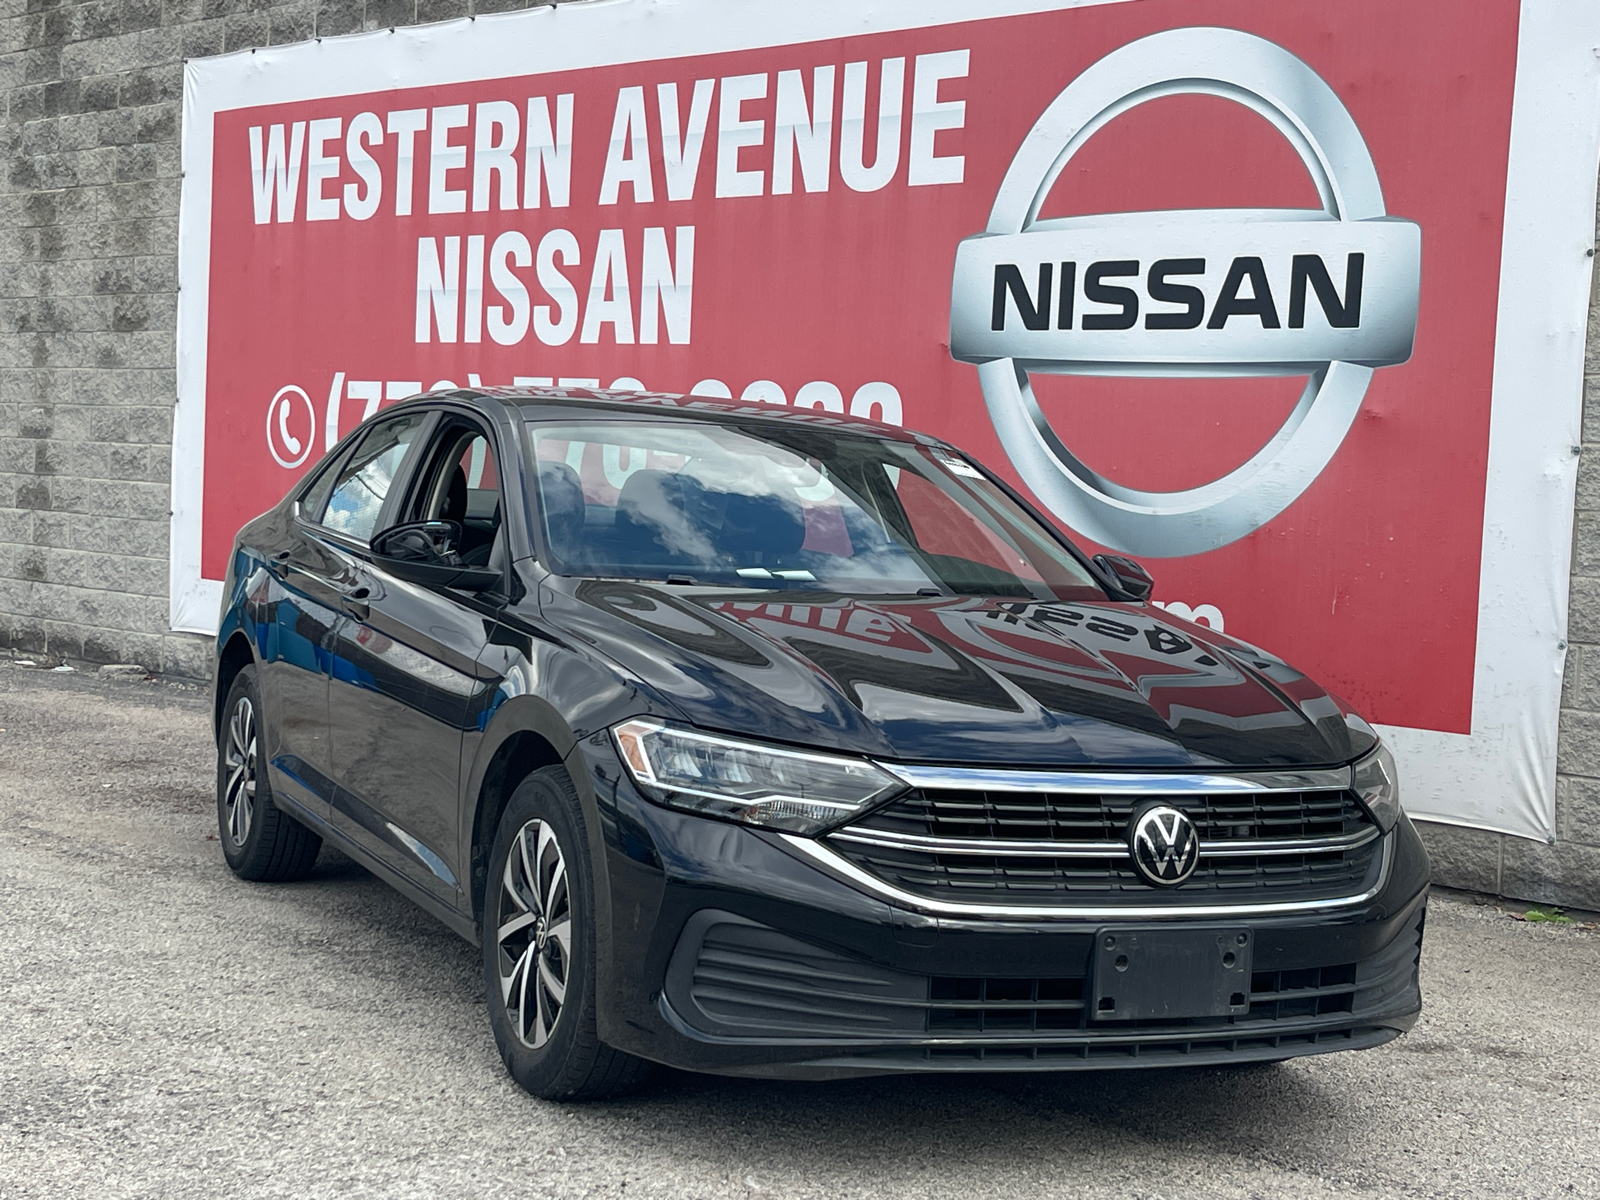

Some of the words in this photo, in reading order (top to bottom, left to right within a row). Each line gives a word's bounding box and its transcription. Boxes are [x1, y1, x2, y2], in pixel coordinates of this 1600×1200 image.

[248, 93, 575, 225] WESTERN
[598, 48, 971, 207] AVENUE
[414, 225, 695, 347] NISSAN
[991, 252, 1365, 331] NISSAN
